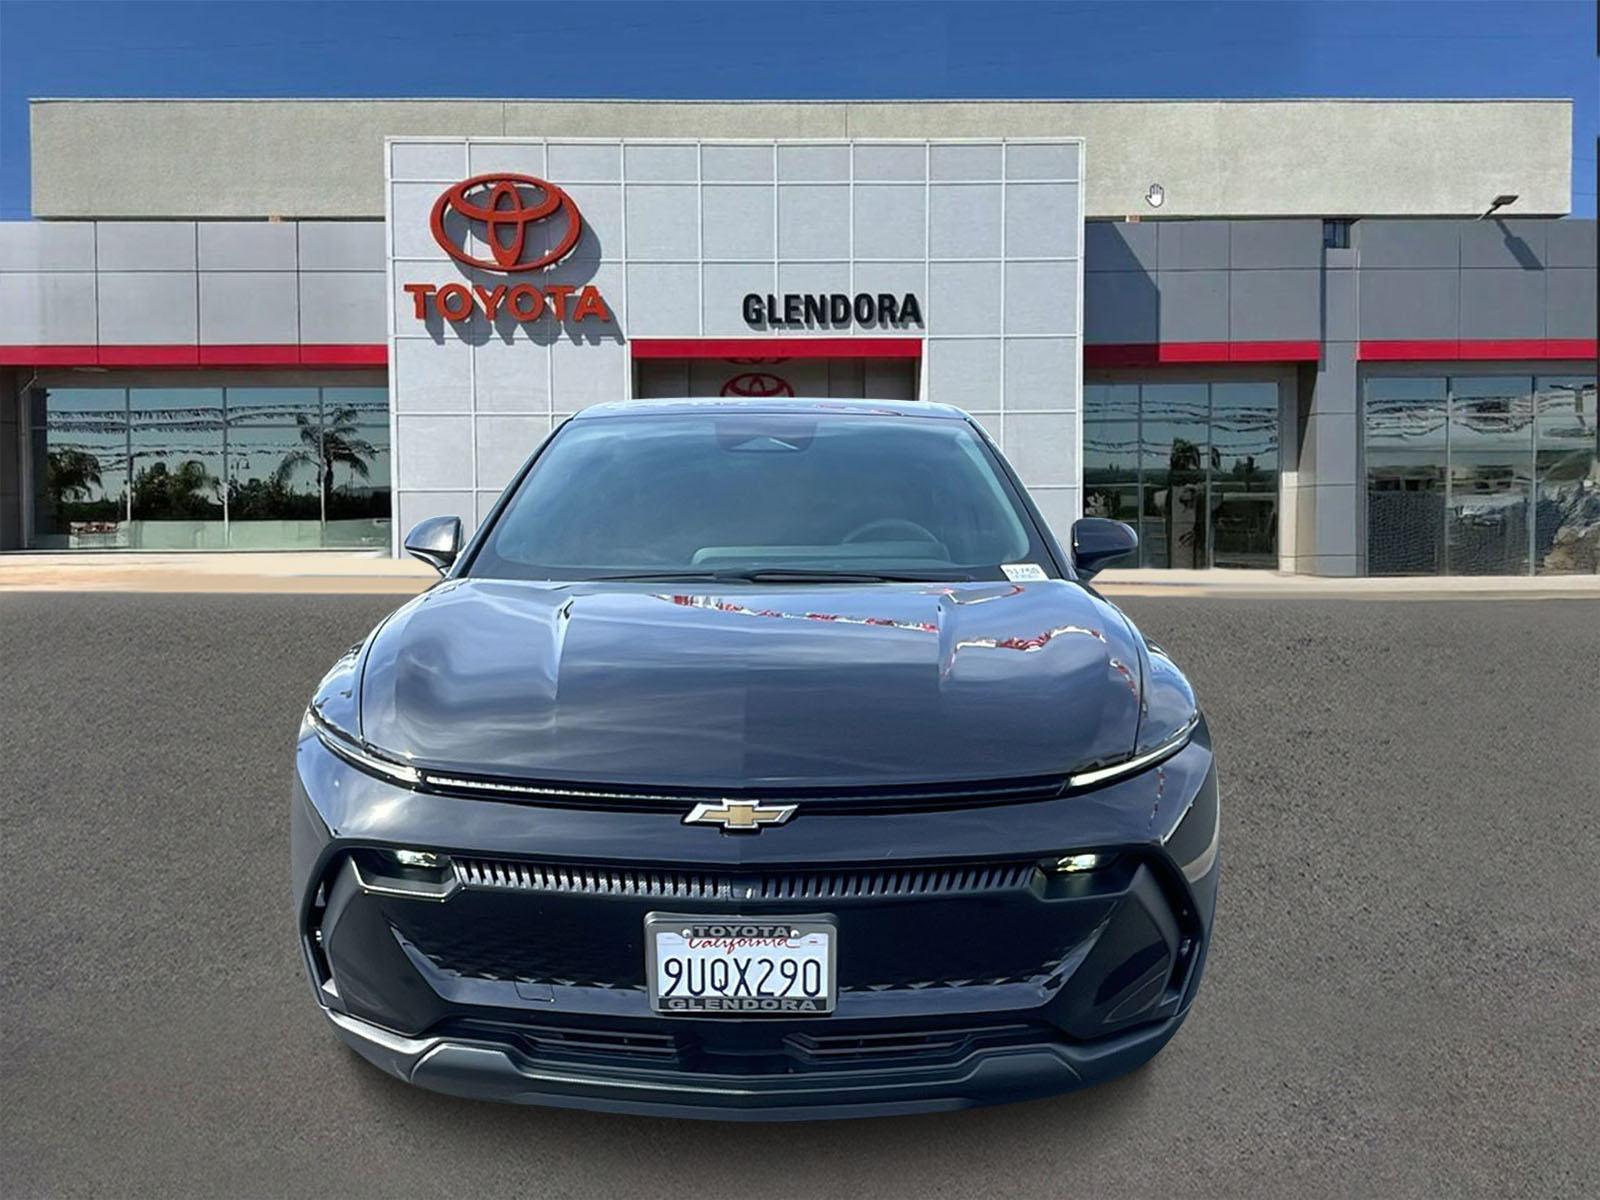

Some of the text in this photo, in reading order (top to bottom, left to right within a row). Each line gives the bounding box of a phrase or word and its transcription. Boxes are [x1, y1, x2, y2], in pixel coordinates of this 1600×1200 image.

[404, 284, 610, 322] TOYOTA
[742, 293, 922, 324] GLENDORA
[694, 926, 789, 937] TOYOTA
[688, 937, 800, 955] California
[664, 958, 821, 997] 9UQX290
[668, 999, 817, 1010] GLENDORA
